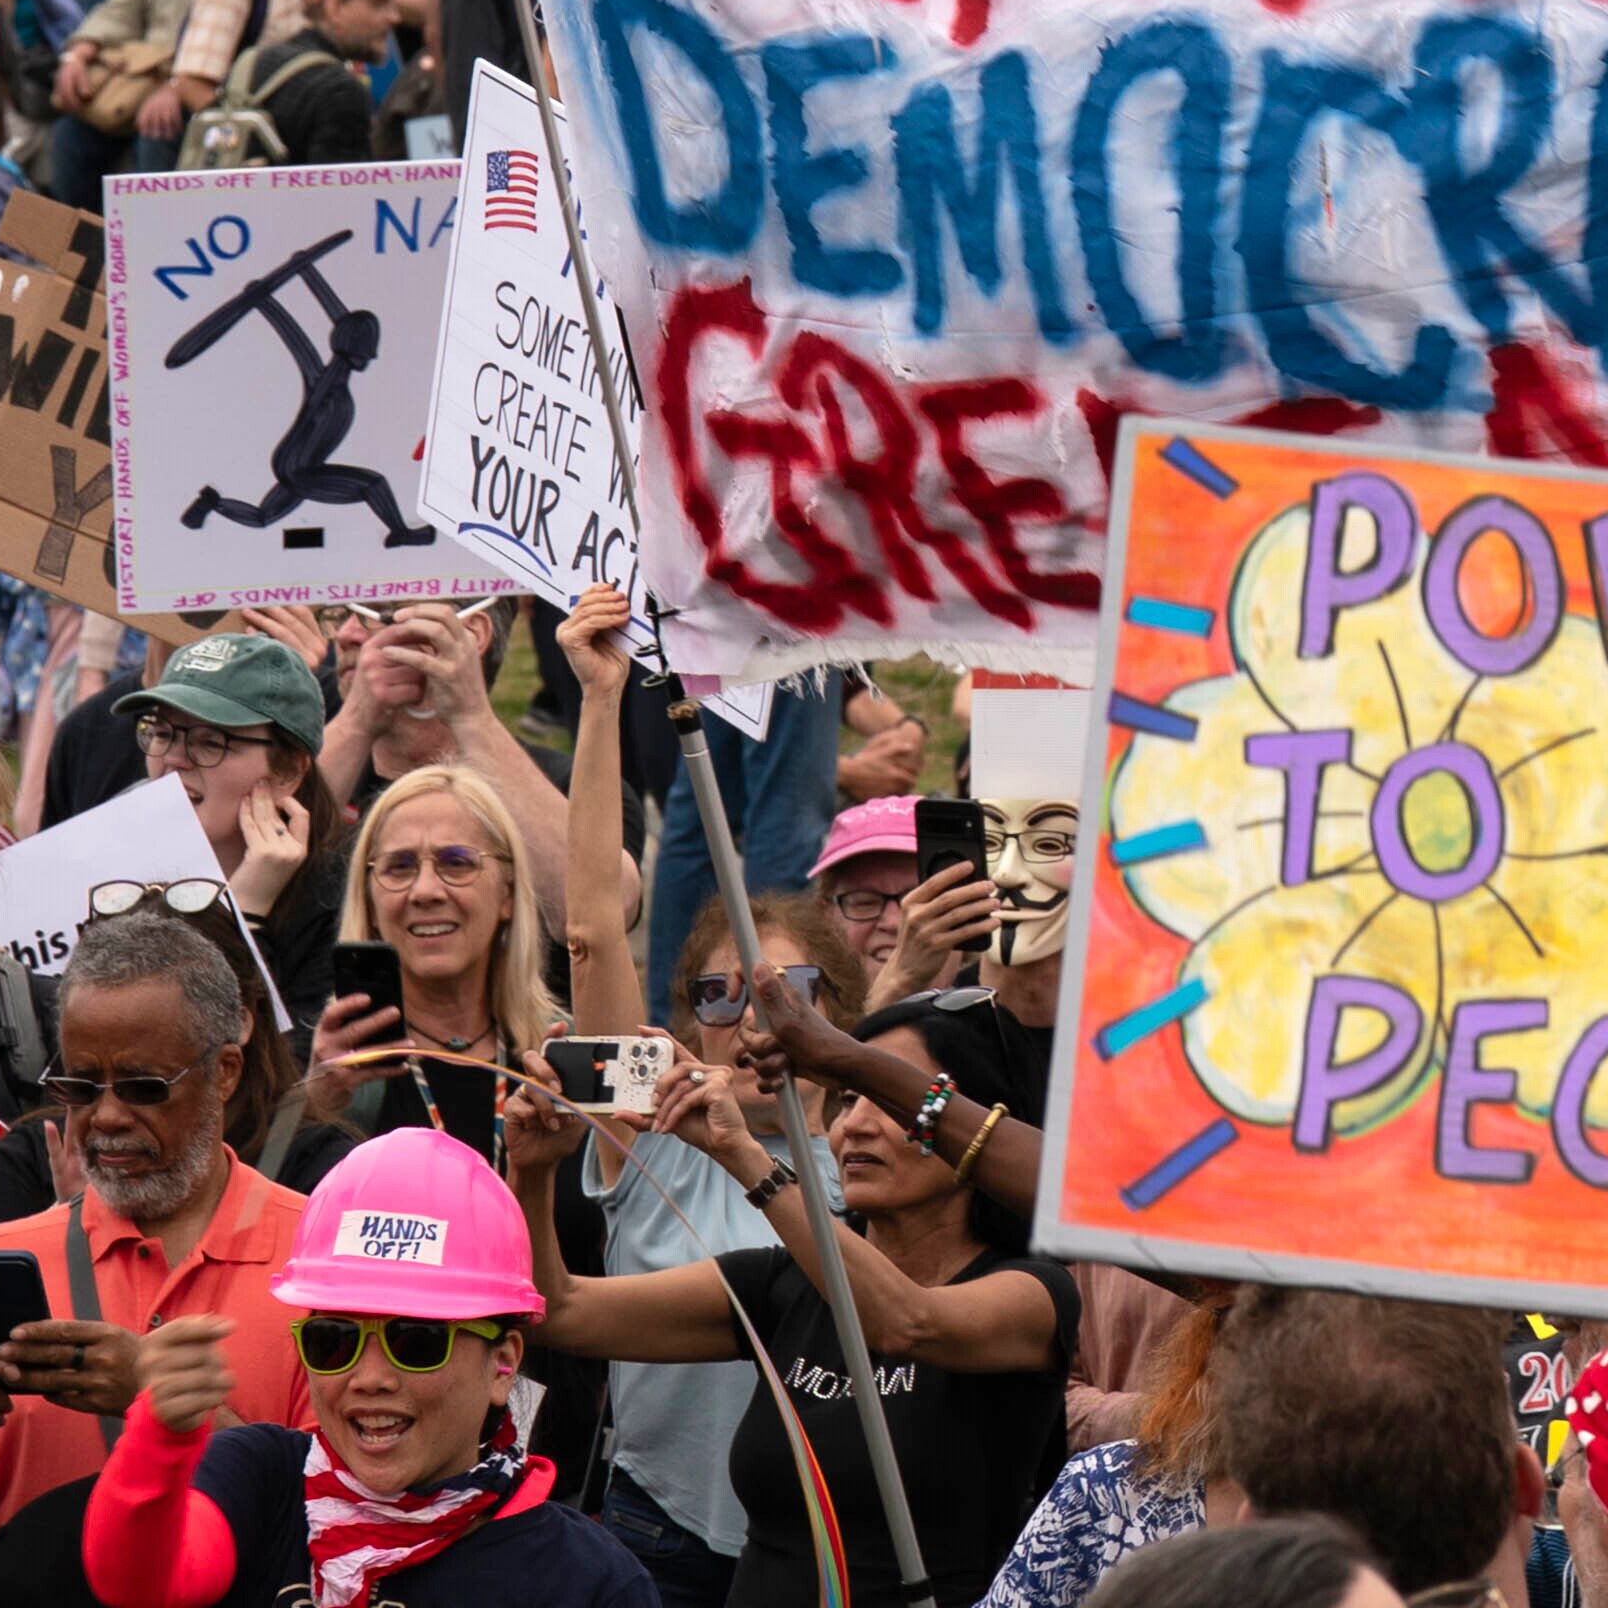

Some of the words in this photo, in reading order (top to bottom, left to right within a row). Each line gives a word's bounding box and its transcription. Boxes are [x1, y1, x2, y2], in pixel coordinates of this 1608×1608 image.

[113, 175, 205, 195] HANDS
[214, 171, 258, 189] OFF
[109, 218, 128, 284] BODIES
[152, 215, 252, 304] NO
[113, 391, 131, 428] OFF
[473, 361, 594, 484] CREATE
[114, 437, 133, 499] HANDS
[469, 434, 561, 568] YOUR
[117, 514, 137, 609] HISTORY
[328, 577, 441, 601] BENEFITS
[230, 583, 312, 607] HANDS
[1243, 726, 1507, 904] TO
[359, 1215, 438, 1243] HANDS
[363, 1237, 422, 1263] OFF!
